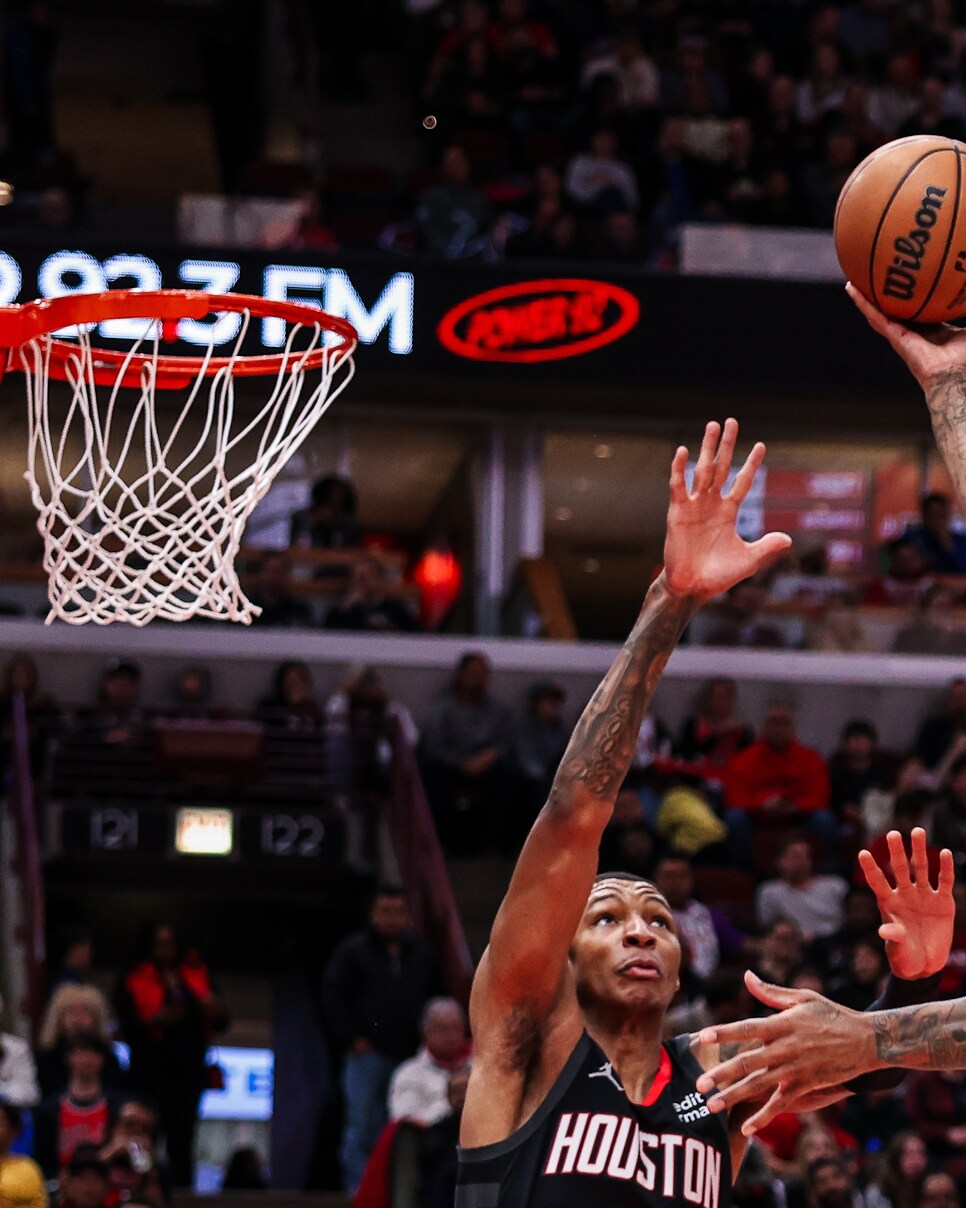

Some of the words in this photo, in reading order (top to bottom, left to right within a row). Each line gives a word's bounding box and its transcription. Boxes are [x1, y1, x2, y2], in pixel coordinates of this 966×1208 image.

[882, 185, 947, 300] Wilson
[38, 249, 241, 345] 923
[261, 264, 414, 354] FM
[90, 808, 139, 850] 121
[261, 814, 325, 856] 122
[673, 1092, 704, 1113] edit
